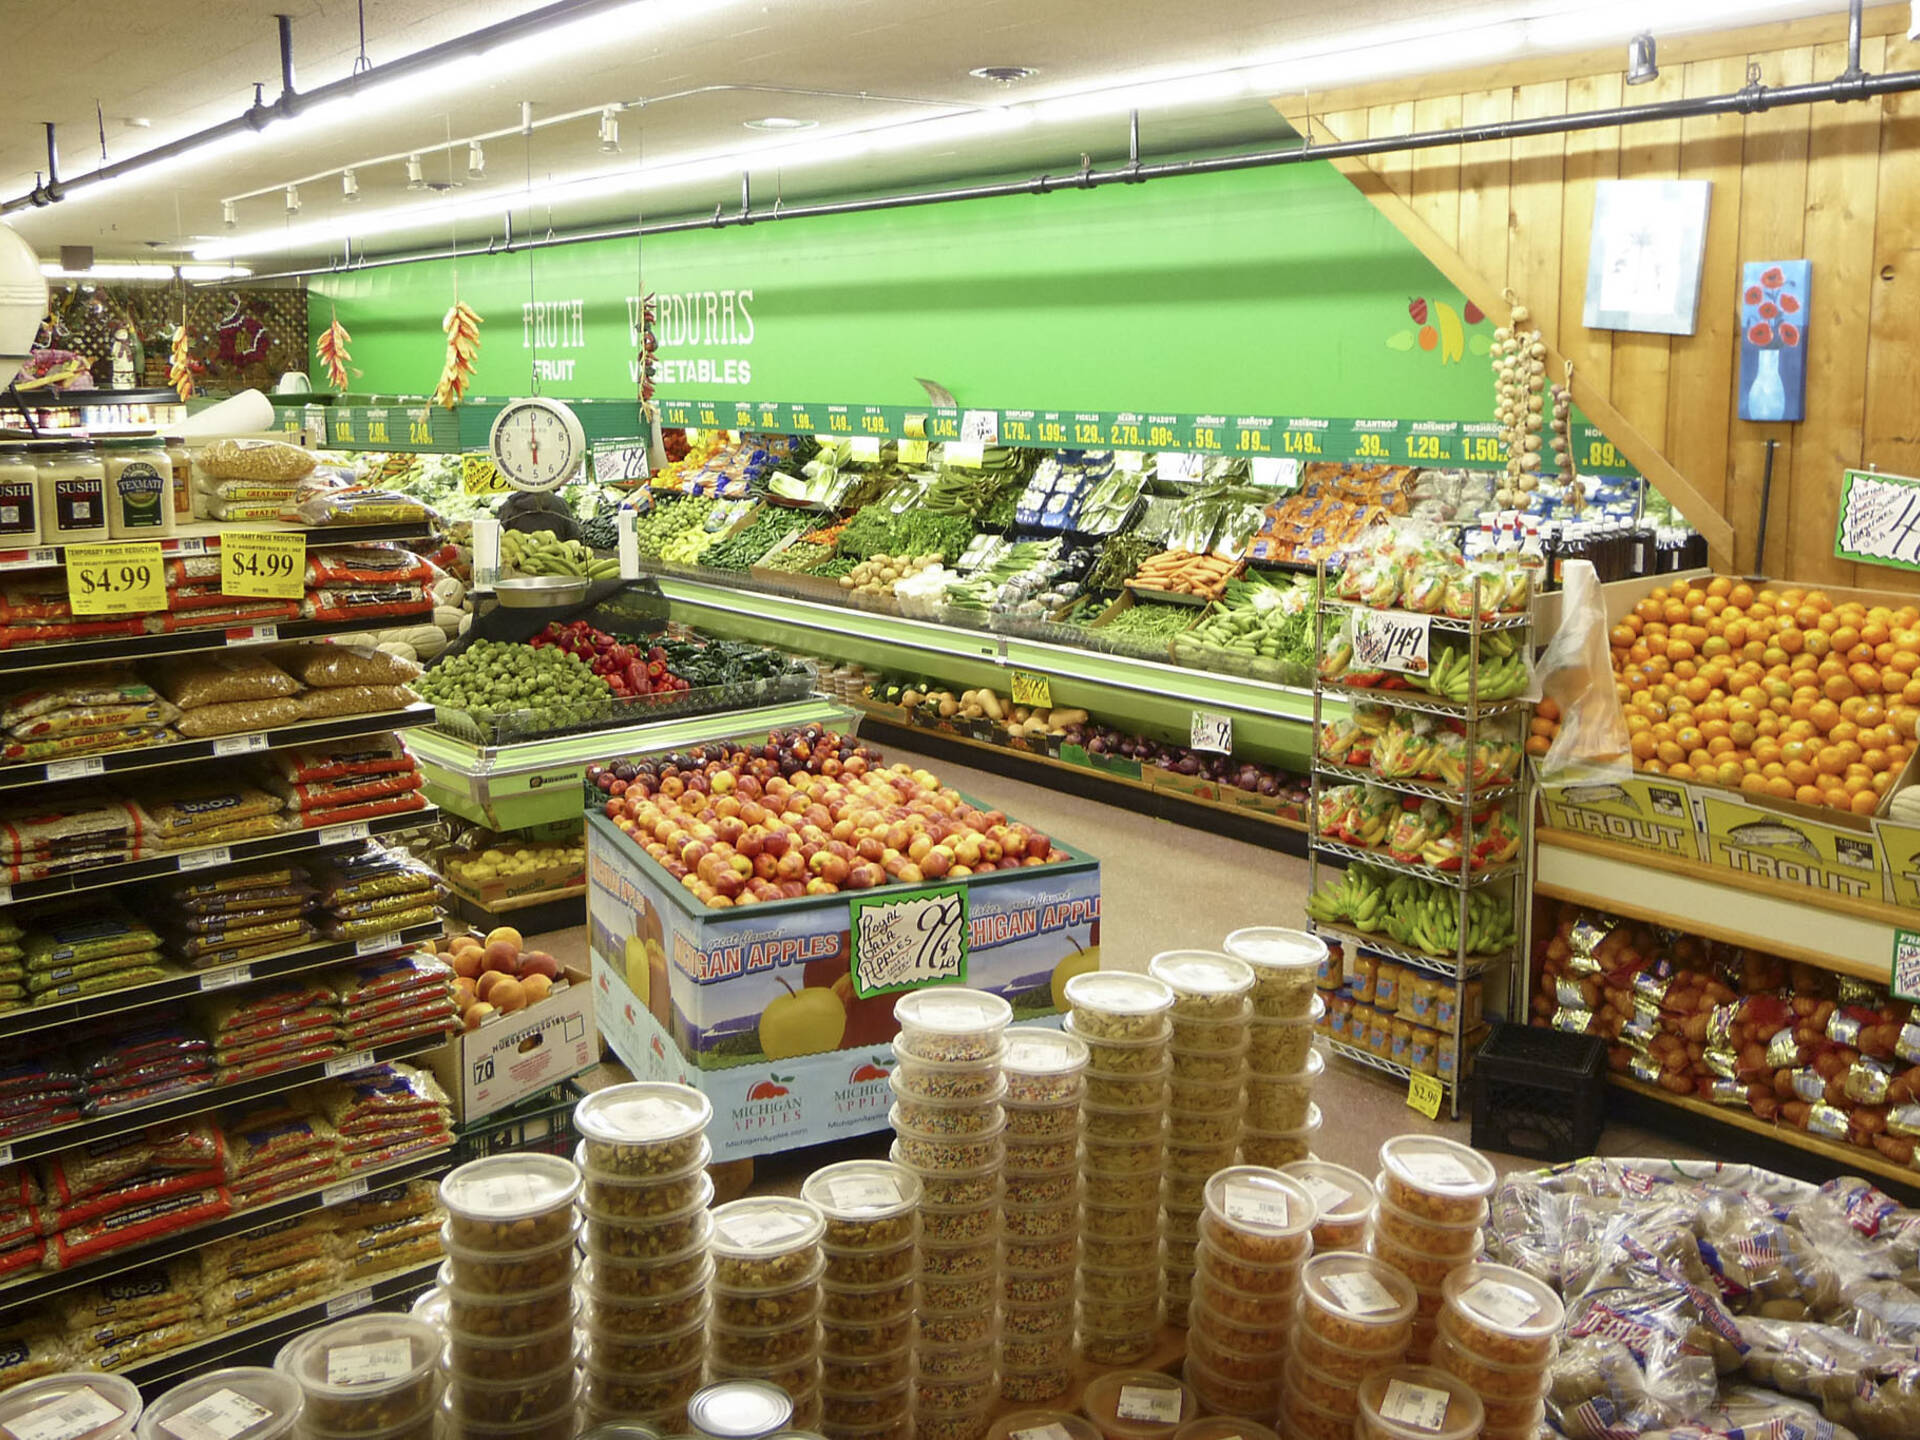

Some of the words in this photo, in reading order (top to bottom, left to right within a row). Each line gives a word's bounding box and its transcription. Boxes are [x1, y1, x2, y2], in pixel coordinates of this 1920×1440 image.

[522, 298, 584, 348] FRUTA
[625, 290, 754, 346] VRDURAS
[533, 359, 576, 381] FRUIT
[629, 359, 751, 384] VGETABLES
[1004, 422, 1024, 440] 1.79
[1038, 423, 1060, 442] 1.99
[1075, 424, 1098, 443] 1.29
[1111, 426, 1138, 445] 2.79
[1355, 420, 1391, 429] CILANTRO
[1188, 428, 1213, 448] .59
[1236, 430, 1260, 451] .89
[1283, 431, 1314, 453] 1.49
[1355, 434, 1380, 456] .39
[1406, 436, 1440, 459] 1.29
[1462, 437, 1498, 461] 1.50
[1582, 442, 1614, 467] .89
[57, 481, 100, 494] SUSHI
[246, 490, 271, 498] GREAT
[256, 534, 272, 542] PRICE
[273, 535, 304, 543] REDUCTION
[125, 546, 159, 555] REDUCTION
[232, 552, 294, 578] $4.99
[80, 565, 151, 594] $4.99
[1557, 804, 1684, 850] TROUT
[1719, 842, 1870, 899] TROUT
[1042, 898, 1102, 928] APPL
[747, 934, 839, 970] APPLES
[475, 1060, 495, 1083] 70
[834, 1082, 892, 1102] MICHIGA
[732, 1097, 802, 1121] MICHIGAN
[733, 1110, 801, 1132] APPLES
